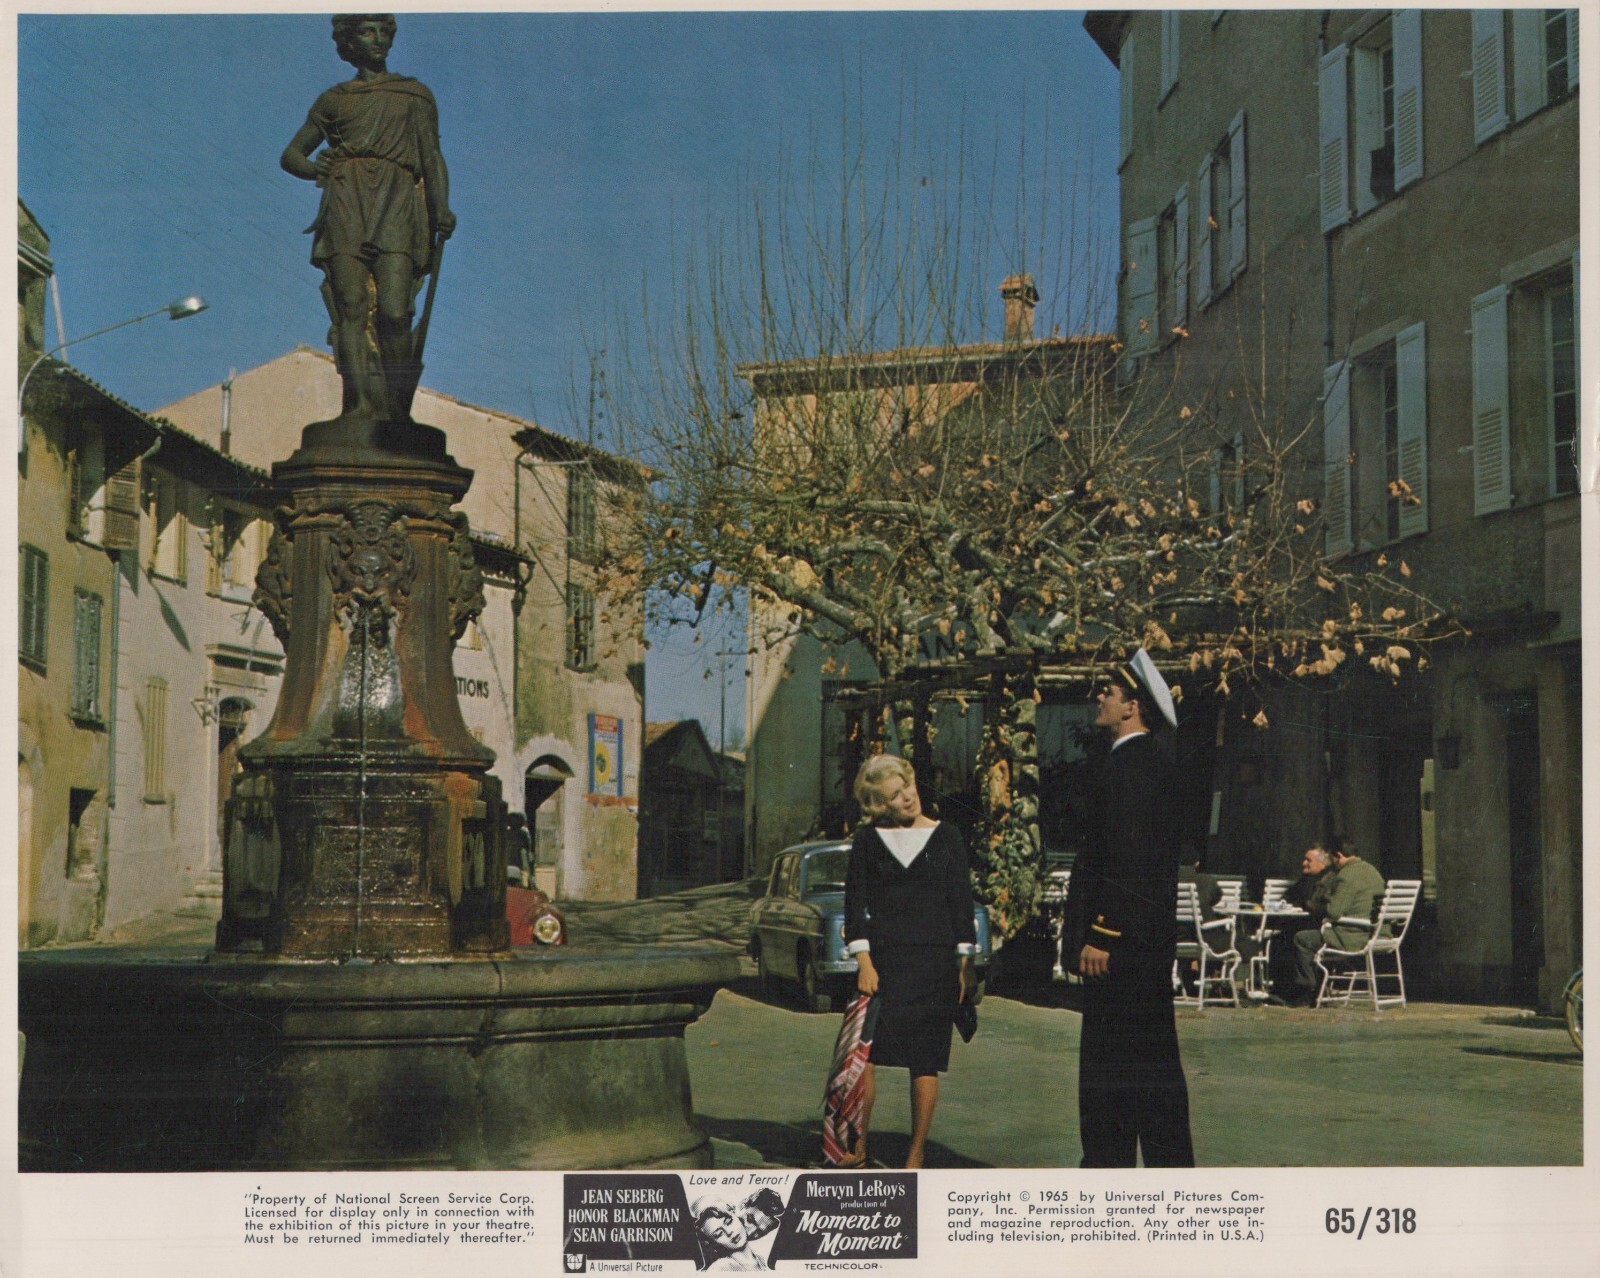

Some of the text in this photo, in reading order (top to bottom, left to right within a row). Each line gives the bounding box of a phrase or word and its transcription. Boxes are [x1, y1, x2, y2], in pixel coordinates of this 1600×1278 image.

[455, 676, 489, 699] TIONS
[690, 1175, 789, 1186] Love and Terror!
[807, 1181, 854, 1199] Mervyn
[314, 1193, 326, 1204] of
[336, 1193, 390, 1204] National
[399, 1193, 439, 1204] Screen
[449, 1193, 492, 1204] Service
[500, 1194, 534, 1206] Corp.
[581, 1189, 664, 1204] JEAN SEBERG
[948, 1191, 1011, 1203] Copyright
[1039, 1191, 1068, 1202] 1965
[1080, 1191, 1095, 1203] by
[1105, 1191, 1164, 1202] Universal
[1175, 1191, 1222, 1202] Pictures
[1231, 1191, 1264, 1202] Com-
[880, 1200, 887, 1209] of
[948, 1204, 1264, 1217] pany, Inc. Permission granted for newspaper
[245, 1207, 534, 1219] Licensed for display only in connection with
[568, 1208, 679, 1223] HONOR BLACKMAN
[245, 1220, 534, 1232] the exhibition of this picture in your theatre.
[884, 1213, 901, 1229] to
[948, 1218, 971, 1228] and
[980, 1219, 1042, 1230] magazine
[1050, 1218, 1134, 1230] reproduction.
[1144, 1218, 1168, 1230] Any
[1178, 1218, 1209, 1228] other
[1219, 1220, 1239, 1228] use
[1325, 1207, 1417, 1240] 65/318
[244, 1233, 274, 1244] Must
[284, 1233, 298, 1244] be
[309, 1233, 361, 1244] returned
[372, 1233, 450, 1245] immediately
[574, 1228, 673, 1243] SEAN GARRISON
[948, 1231, 1265, 1243] cluding television, prohibited. (Printed in U.S.A.)
[590, 1262, 663, 1272] A Universal Picture
